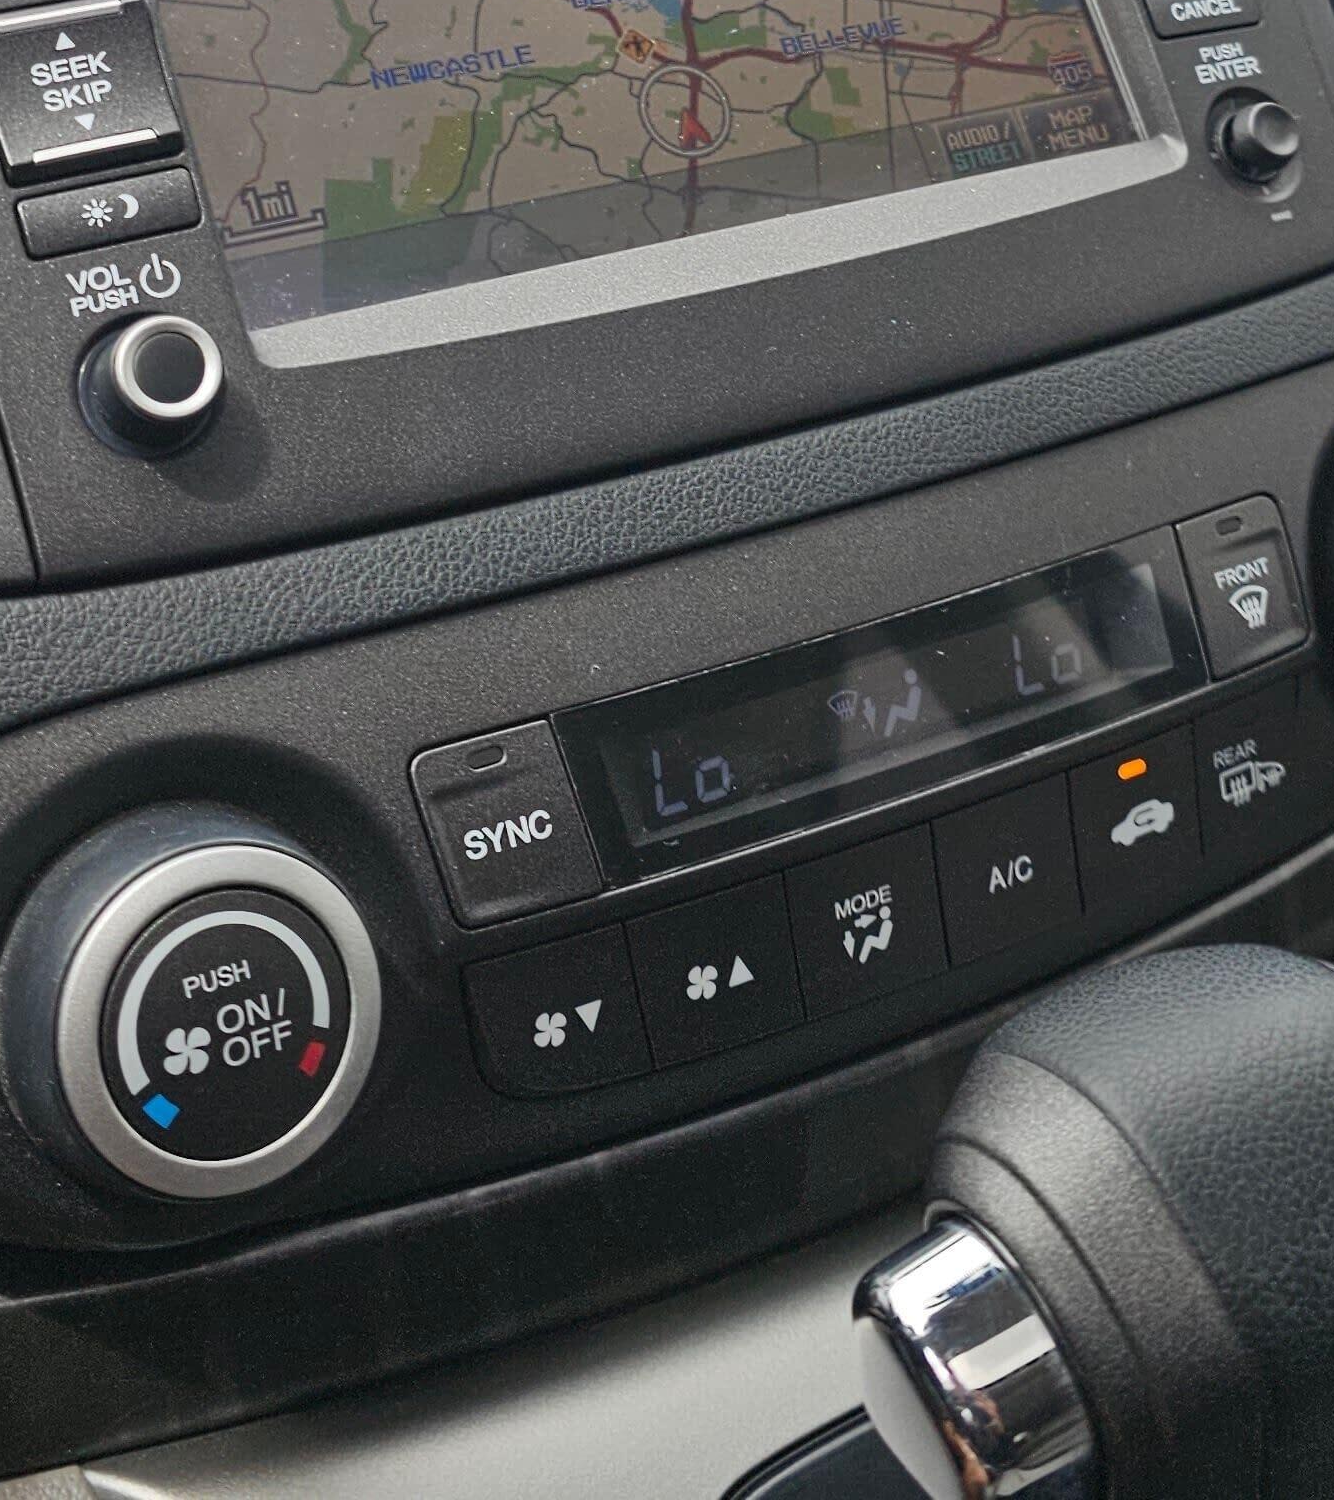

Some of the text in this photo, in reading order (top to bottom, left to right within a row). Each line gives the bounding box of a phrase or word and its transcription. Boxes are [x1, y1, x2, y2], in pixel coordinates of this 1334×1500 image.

[780, 17, 907, 56] BELLEVUE
[1198, 42, 1244, 64] PUSH
[30, 51, 111, 87] SEEK
[371, 44, 536, 90] NEWCASTLE
[1051, 63, 1093, 85] 405
[1194, 56, 1262, 84] ENTER
[42, 79, 113, 112] SKIP
[1048, 105, 1092, 128] MAP
[1048, 123, 1110, 151] MENU
[953, 143, 1023, 172] STREET
[66, 264, 132, 295] VOL
[69, 286, 139, 317] PUSH
[1214, 556, 1269, 590] FRONT
[1213, 739, 1258, 767] REAR
[463, 809, 553, 861] SYNC
[988, 855, 1034, 895] A/C
[834, 885, 893, 920] MODE
[182, 959, 252, 999] PUSH
[222, 1020, 293, 1067] OFF
